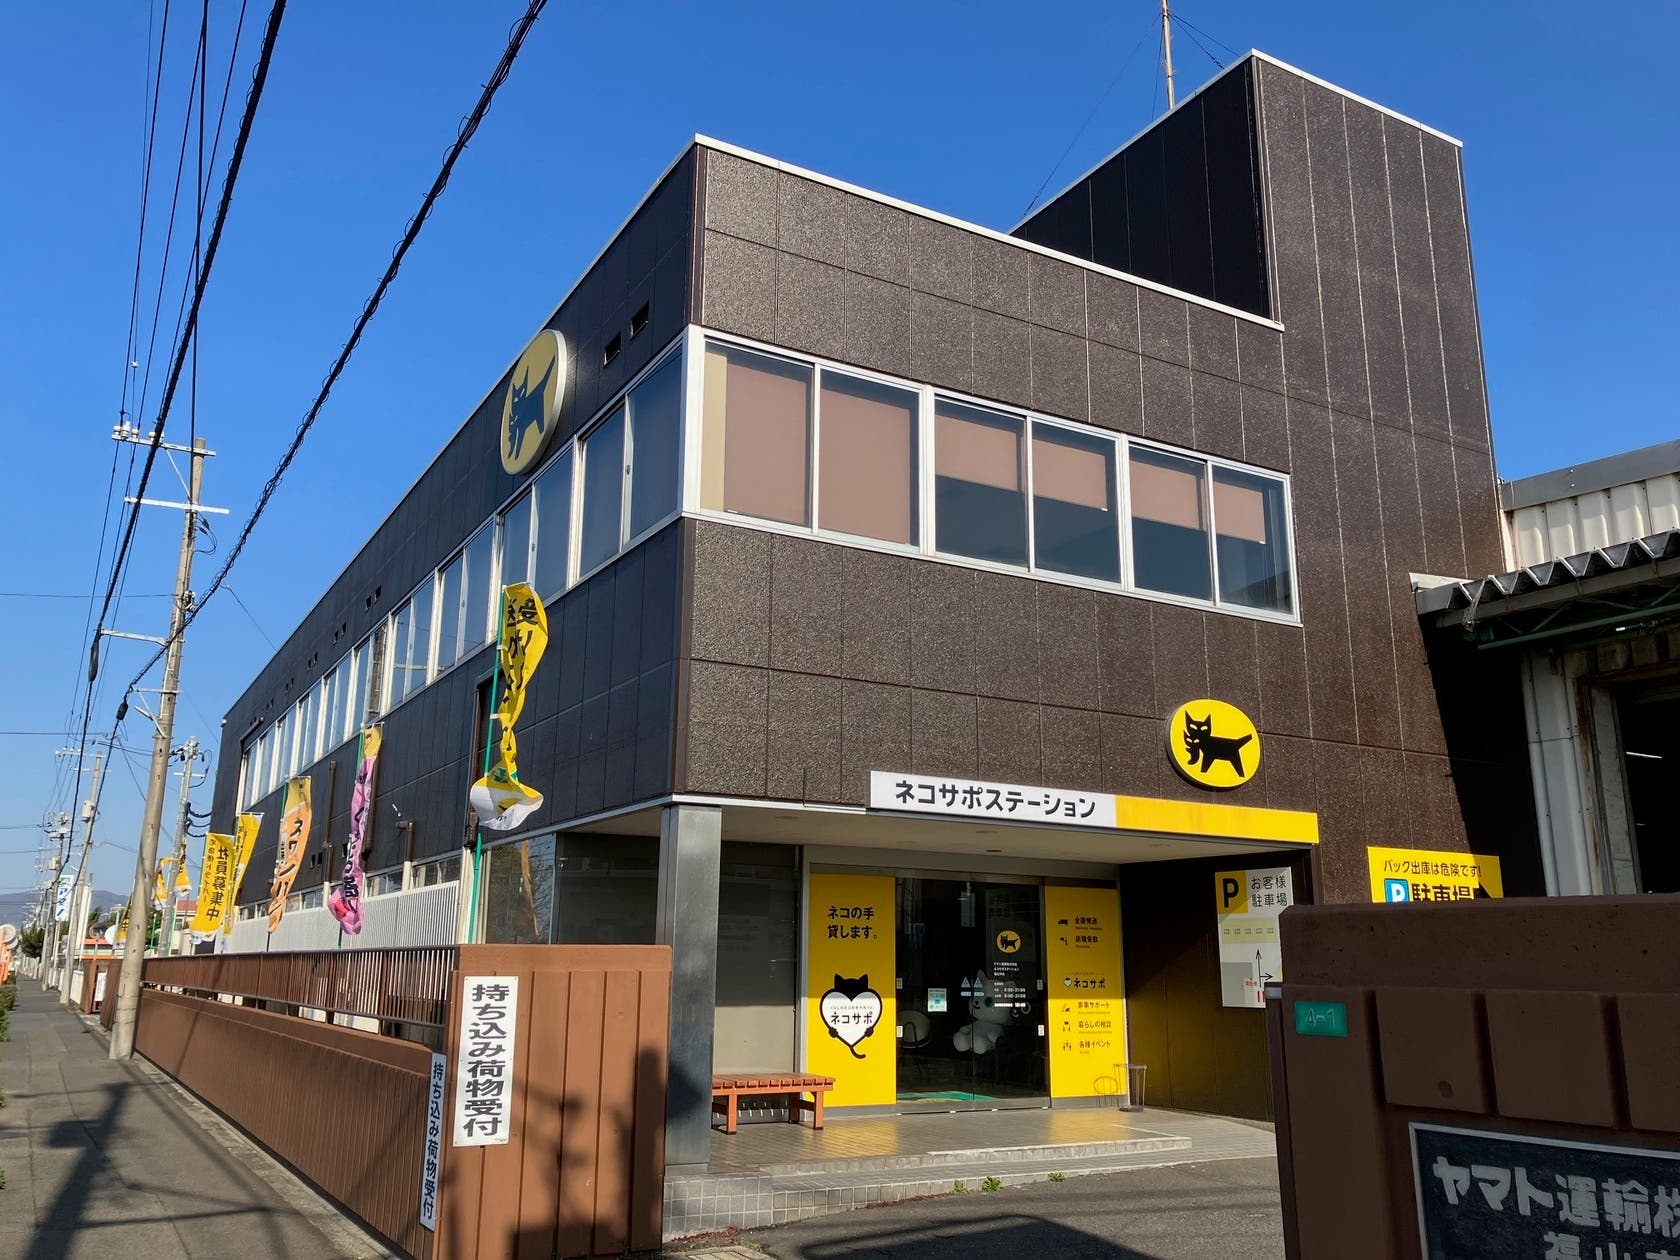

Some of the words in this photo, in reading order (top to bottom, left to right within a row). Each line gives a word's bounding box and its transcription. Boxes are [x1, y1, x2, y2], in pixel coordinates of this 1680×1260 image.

[895, 779, 1096, 819] ネコサポステーション
[206, 846, 229, 921] 社員募集中
[1251, 875, 1287, 890] お客様
[1222, 878, 1239, 908] P
[1252, 893, 1288, 908] 駐車場
[828, 906, 875, 920] ネコの手
[828, 925, 878, 939] 貸します。
[1074, 977, 1106, 989] ネコサポ
[831, 1011, 873, 1025] ネコサポ
[1304, 1007, 1336, 1032] 4-1
[1079, 1040, 1112, 1049] 各種イベント
[462, 984, 510, 1138] 持ち込み荷物受付
[422, 1061, 445, 1220] 持ち込み荷物受付
